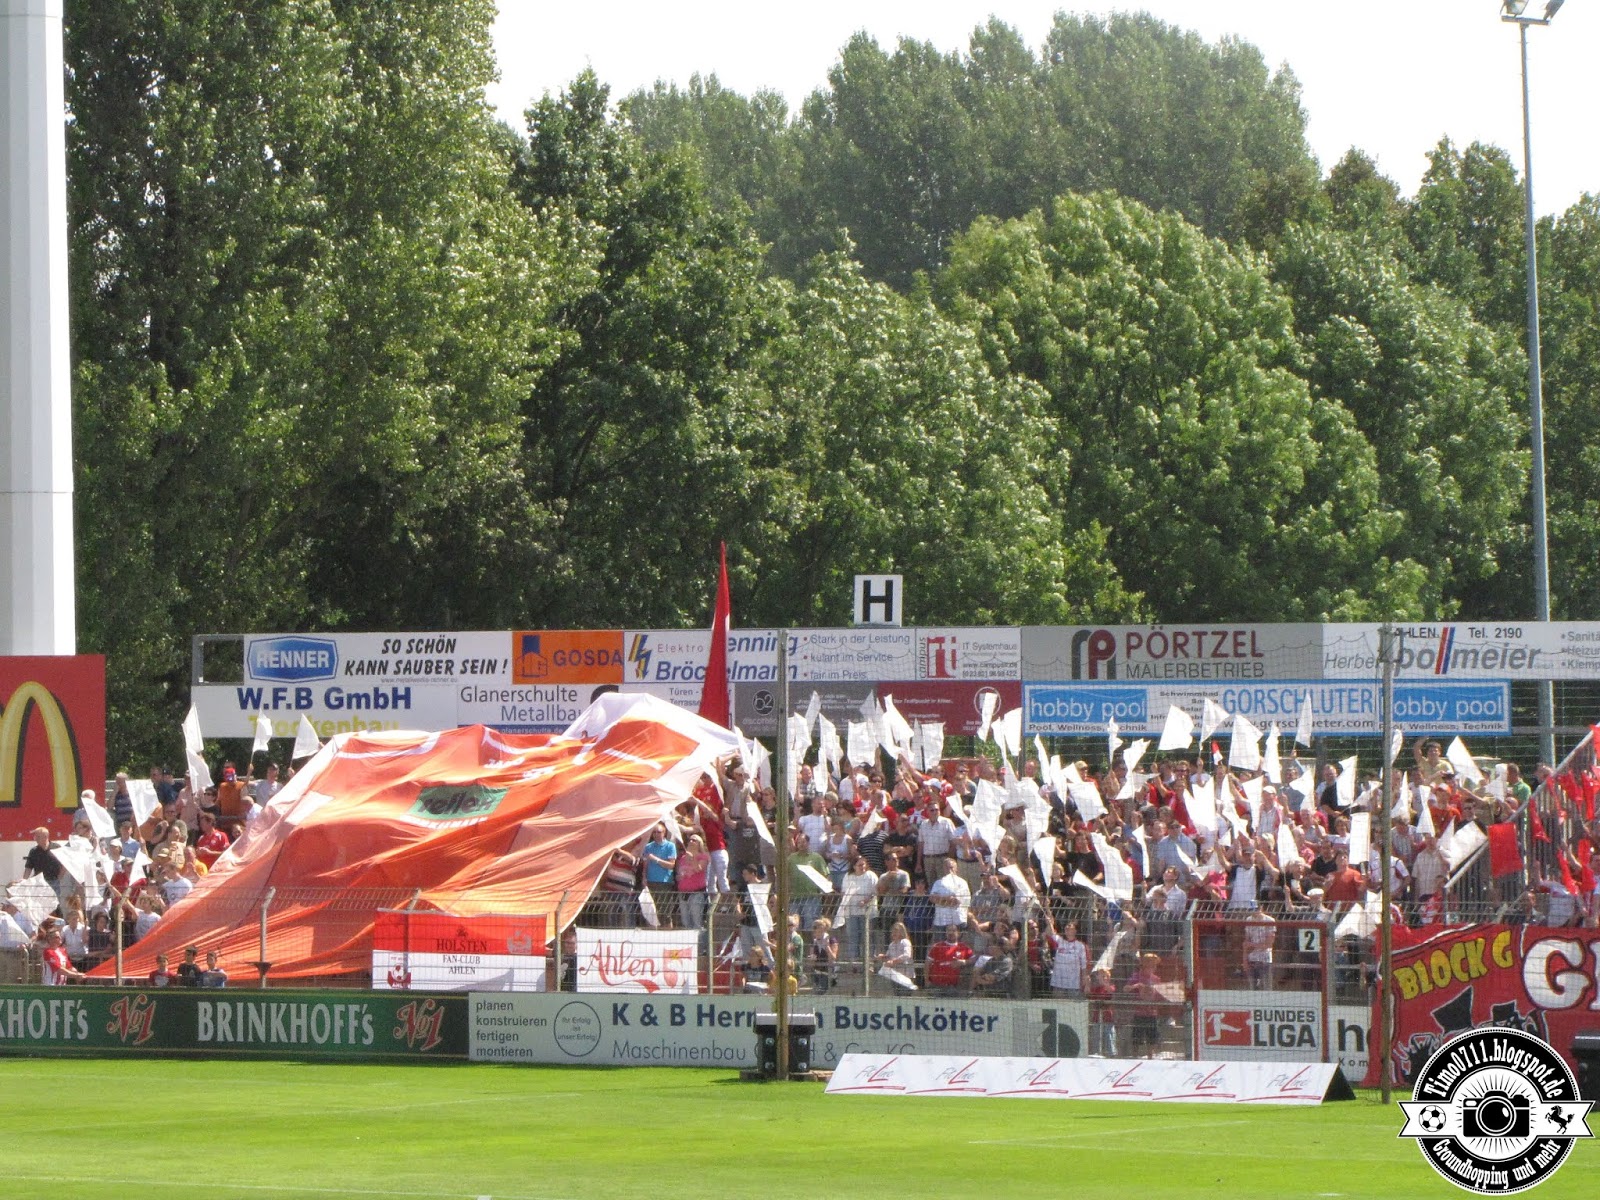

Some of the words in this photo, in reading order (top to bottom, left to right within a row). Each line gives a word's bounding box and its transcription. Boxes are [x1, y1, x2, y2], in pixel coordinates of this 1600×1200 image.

[862, 579, 894, 622] H
[810, 633, 837, 644] Stark
[839, 633, 848, 644] in
[850, 633, 867, 644] der
[868, 633, 910, 647] Leistung
[1468, 627, 1488, 638] Tel.
[1495, 627, 1522, 639] 2190
[382, 639, 402, 654] SO
[406, 634, 457, 654] SCHÖN
[657, 643, 704, 654] Elektro
[962, 642, 970, 651] IT
[972, 641, 1018, 653] Systemhaus
[1125, 625, 1265, 659] PÖRTZEL
[256, 650, 330, 669] RENNER
[553, 650, 624, 667] GOSDA
[810, 651, 839, 663] kulant
[841, 652, 854, 663] im
[856, 652, 894, 663] Service
[919, 637, 927, 679] campus
[1324, 652, 1377, 669] Herbe
[344, 660, 389, 676] KANN
[393, 659, 454, 676] SAUBER
[459, 659, 497, 675] SEIN
[810, 669, 826, 680] fair
[827, 669, 840, 680] im
[844, 669, 868, 680] Preis
[1125, 662, 1265, 679] MALERBETRIEB
[236, 687, 314, 710] W.F.B
[324, 687, 412, 710] GmbH
[460, 685, 578, 703] Glanerschulte
[669, 687, 694, 697] Türen
[1031, 697, 1094, 721] hobby
[1101, 698, 1146, 721] pool
[1393, 695, 1448, 720] obby
[1455, 695, 1503, 719] pool
[1028, 723, 1055, 732] Pool,
[1057, 723, 1105, 733] Wellness,
[1119, 723, 1148, 732] chnik
[1408, 722, 1460, 731] Wellness,
[1463, 722, 1503, 730] Technik
[436, 938, 487, 952] HOLSTEN
[1304, 930, 1315, 951] 2
[442, 955, 481, 965] FAN-CLUB
[579, 939, 659, 985] Ahlen
[1392, 938, 1489, 1000] BLOCK
[1491, 930, 1515, 969] G
[448, 966, 476, 975] AHLEN
[1523, 937, 1600, 1010] G
[475, 1000, 514, 1013] planen
[197, 1001, 375, 1045] BRINKHOFF's
[475, 1014, 547, 1026] konstruieren
[572, 1016, 591, 1025] Erfolg
[611, 1003, 630, 1026] K
[639, 1003, 659, 1027] &
[669, 1003, 686, 1026] B
[835, 1005, 999, 1033] Buschkötter
[1253, 1009, 1315, 1022] BUNDES
[475, 1030, 519, 1044] fertigen
[1253, 1024, 1316, 1048] LIGA
[475, 1046, 534, 1058] montieren
[612, 1039, 747, 1061] Maschinenbau
[823, 1042, 838, 1062] &
